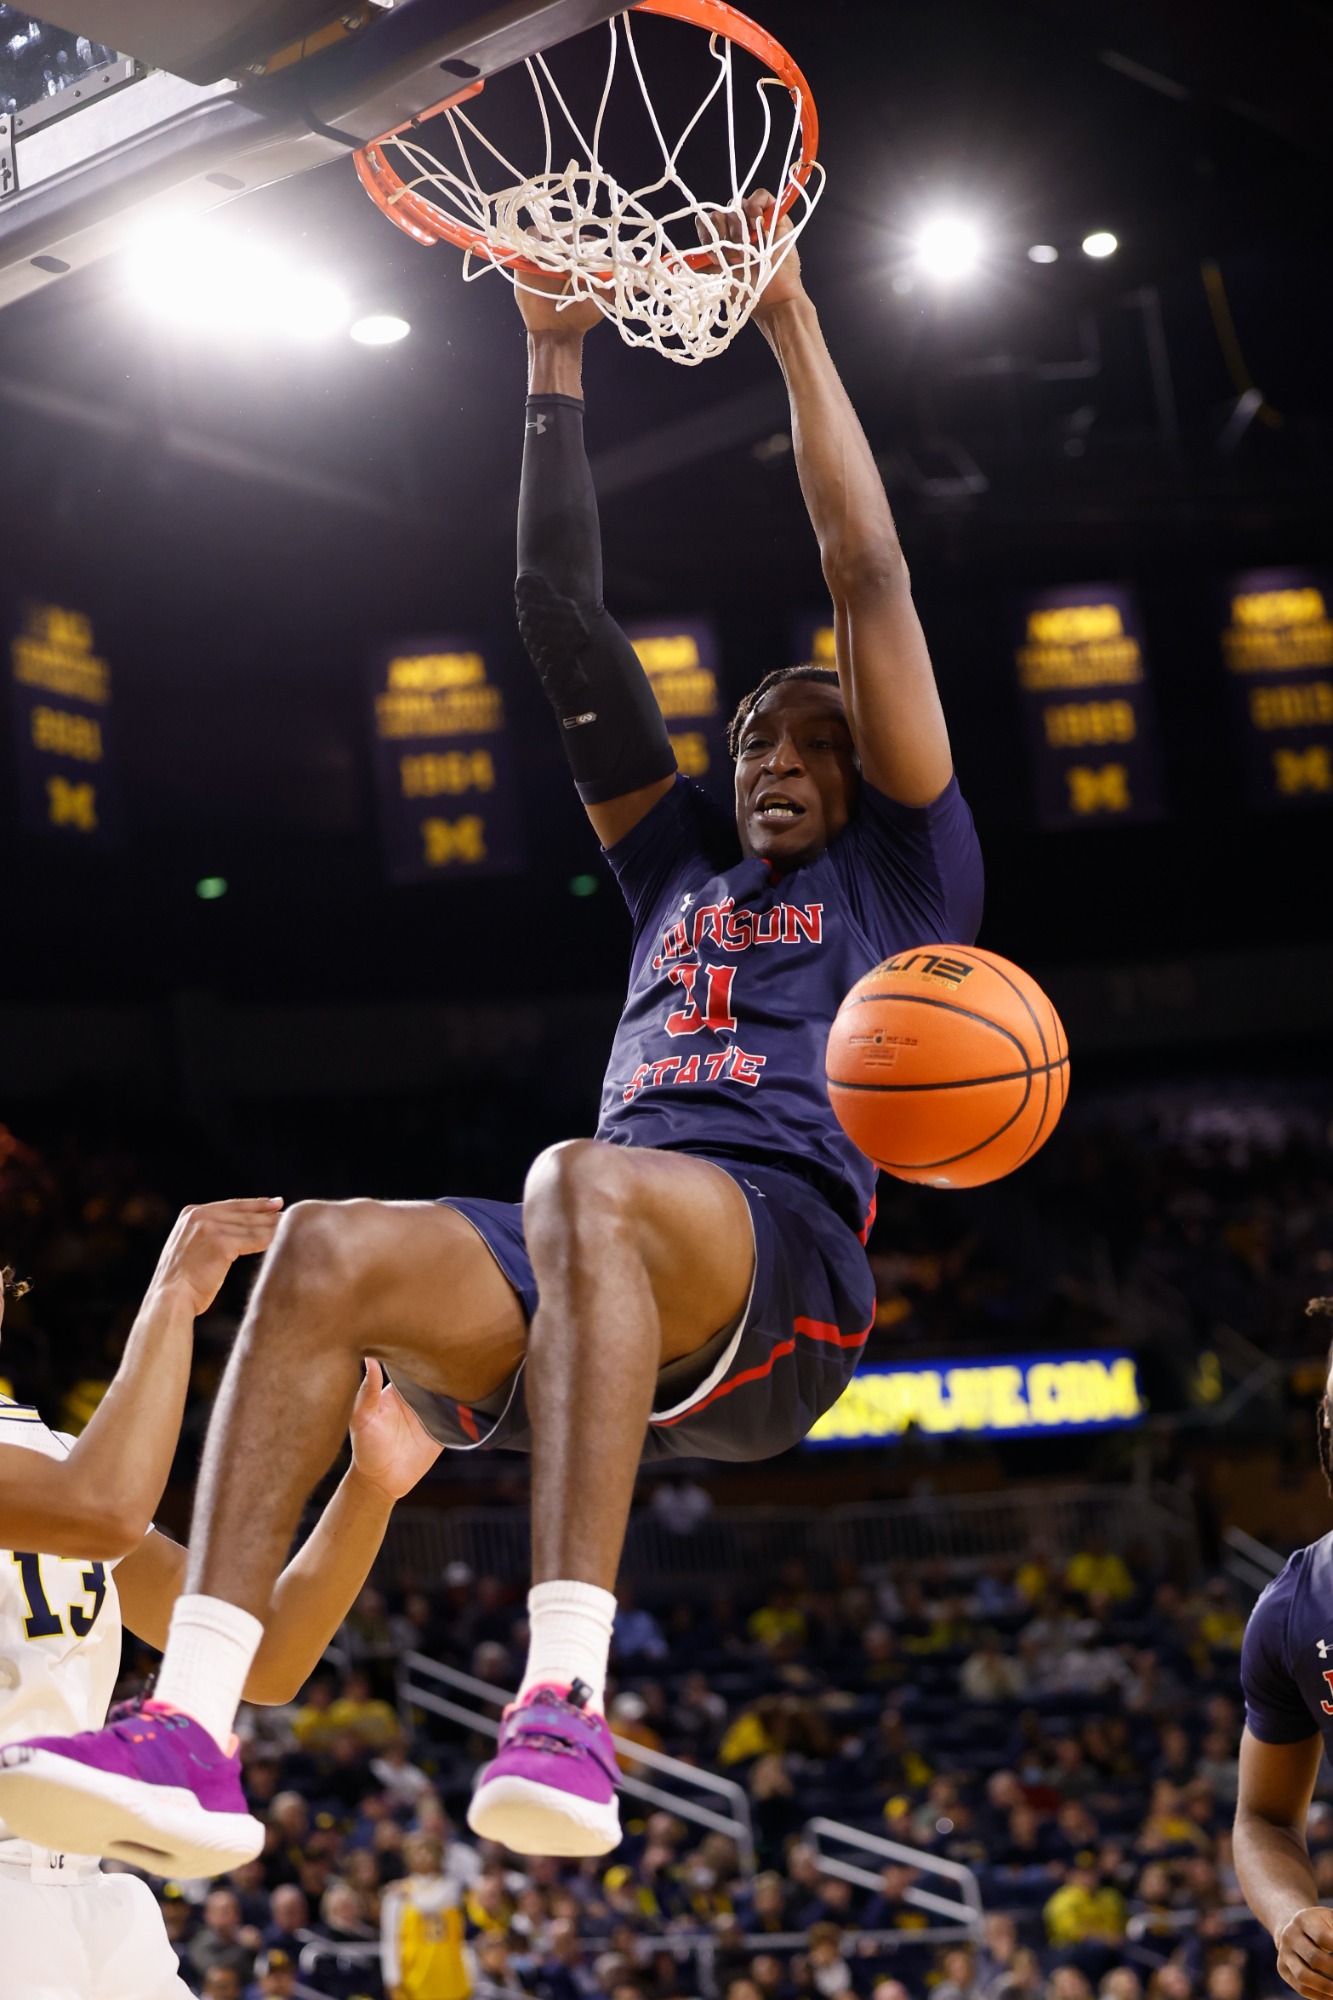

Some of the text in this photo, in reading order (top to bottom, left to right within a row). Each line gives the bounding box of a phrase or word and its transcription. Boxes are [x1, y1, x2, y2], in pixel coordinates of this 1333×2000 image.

[664, 963, 738, 1038] 31
[623, 1046, 767, 1104] STATE
[10, 1550, 107, 1641] 13
